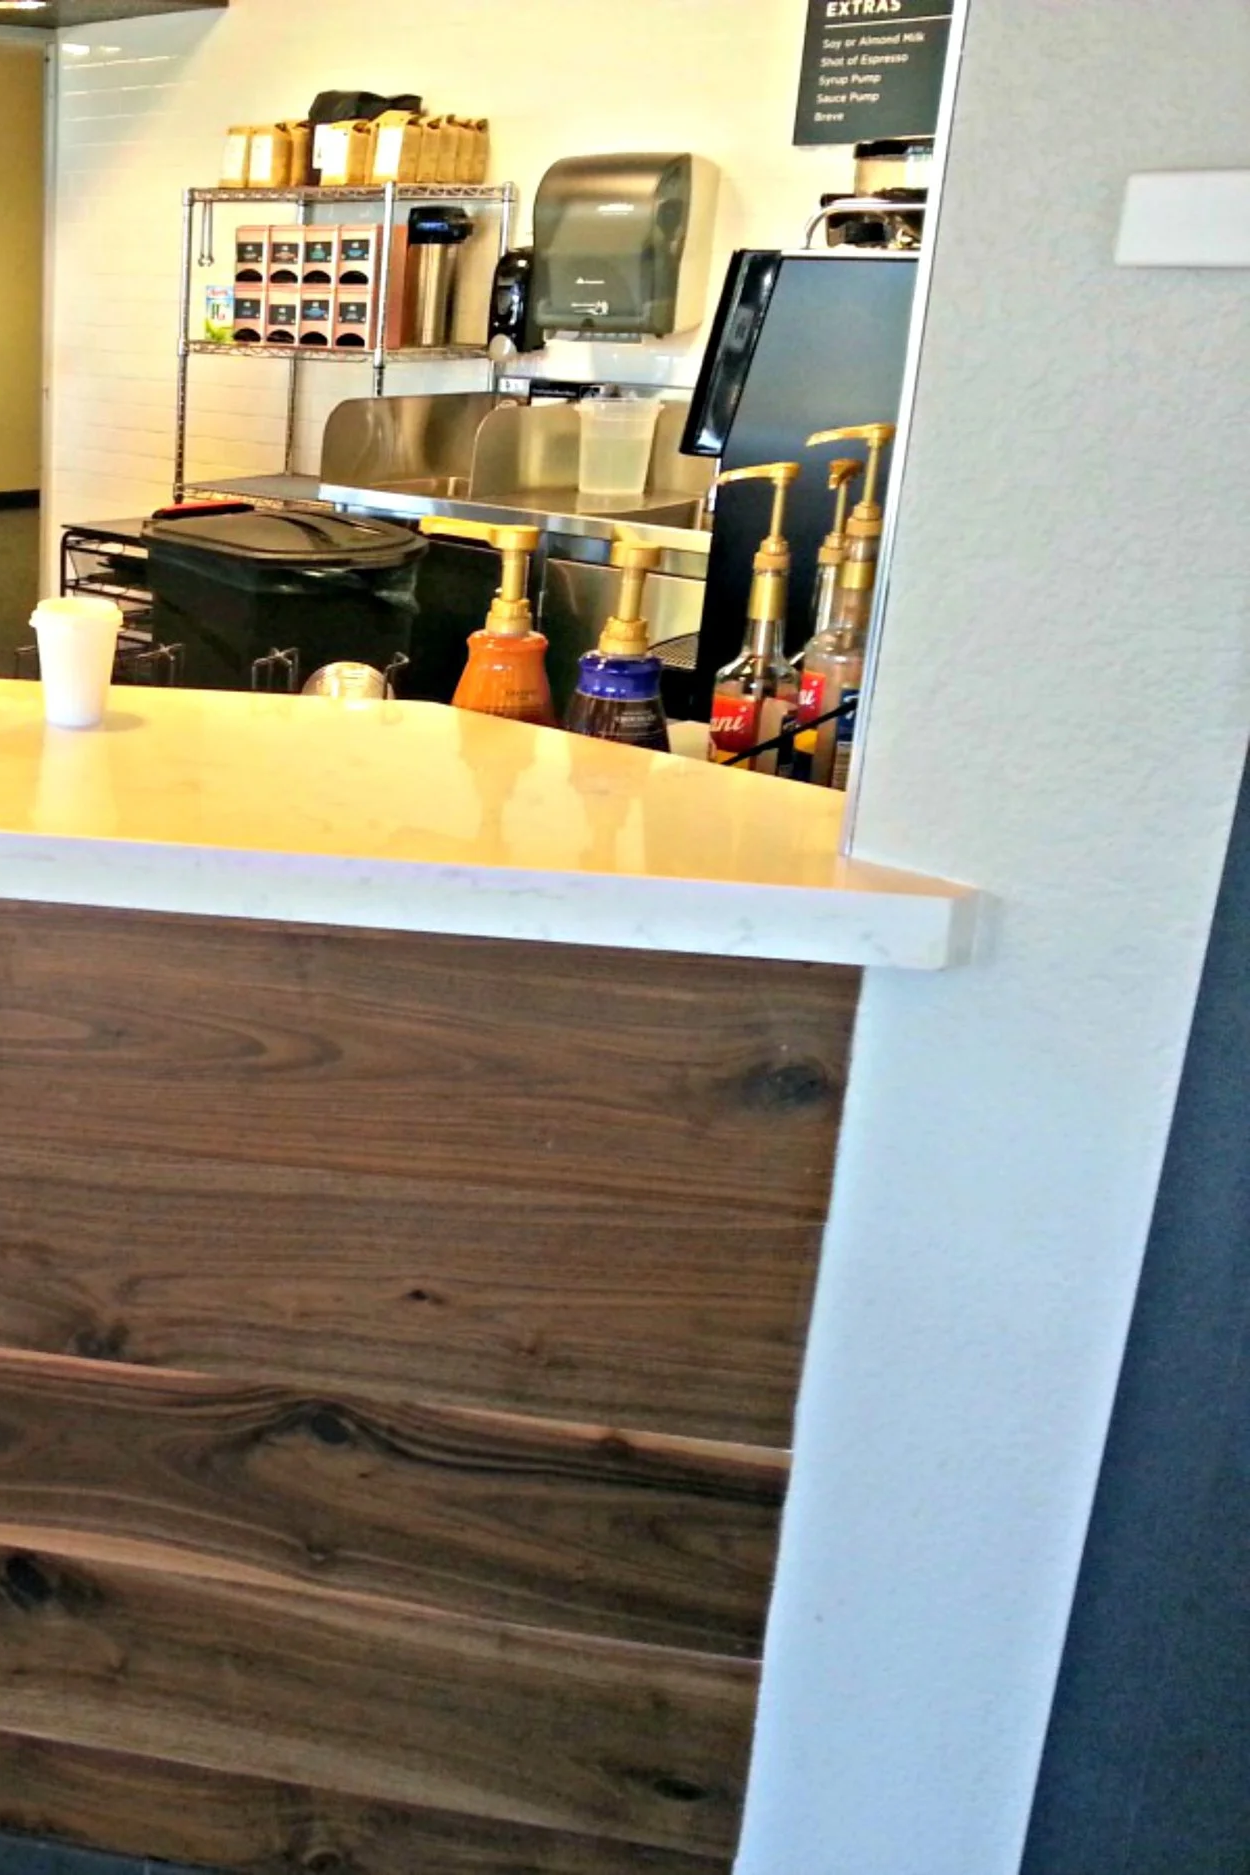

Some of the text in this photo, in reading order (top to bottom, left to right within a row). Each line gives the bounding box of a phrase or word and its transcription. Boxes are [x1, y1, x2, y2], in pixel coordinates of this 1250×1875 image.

[826, 0, 901, 17] EXTRAS
[822, 31, 926, 49] Soy or Almond Milk
[820, 53, 909, 67] Shot of Espresso
[818, 73, 882, 87] Syrup Pump
[816, 91, 880, 104] Sauce Pump
[814, 112, 845, 121] Breve
